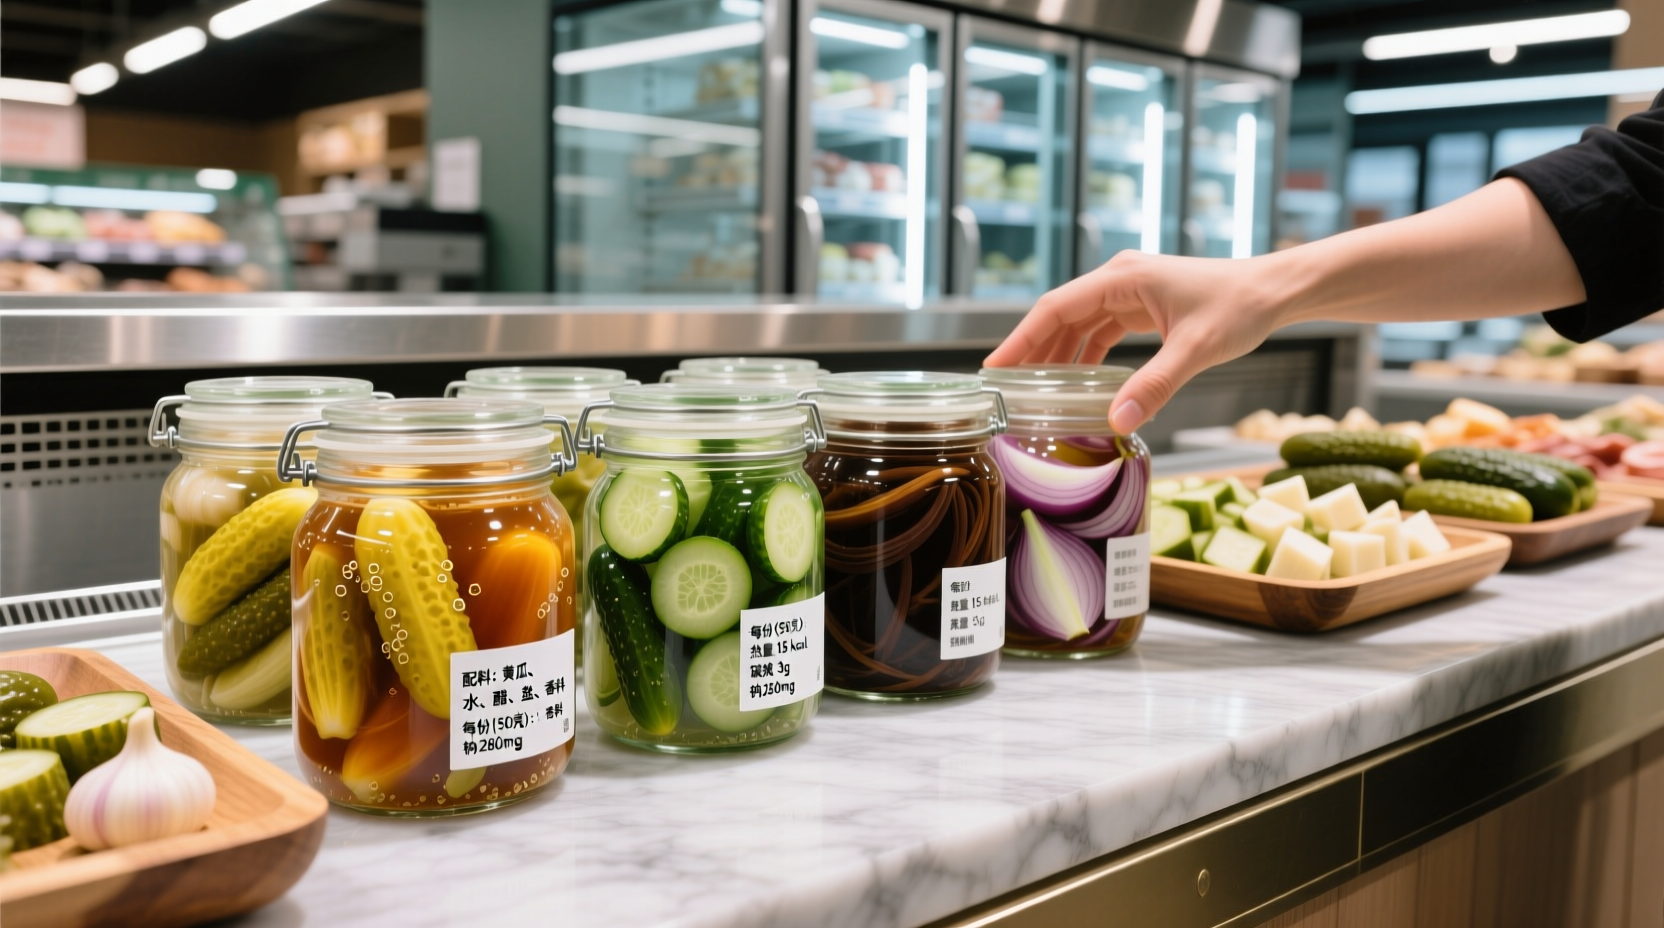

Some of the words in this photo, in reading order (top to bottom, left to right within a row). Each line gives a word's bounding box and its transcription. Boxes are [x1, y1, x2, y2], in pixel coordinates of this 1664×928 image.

[972, 597, 982, 608] 15
[777, 641, 787, 653] 15
[790, 636, 808, 652] kcal
[777, 661, 790, 676] 3g
